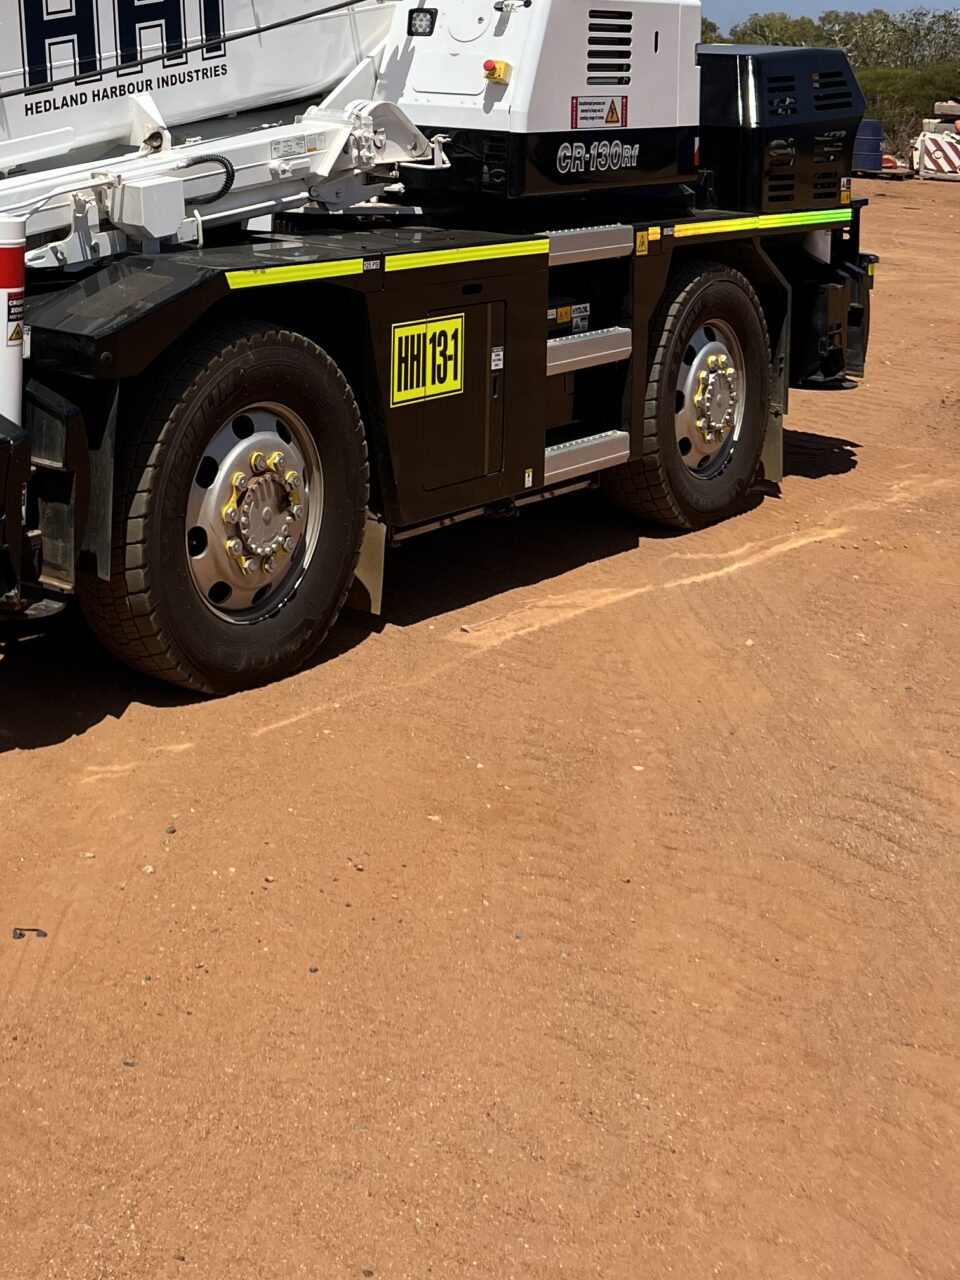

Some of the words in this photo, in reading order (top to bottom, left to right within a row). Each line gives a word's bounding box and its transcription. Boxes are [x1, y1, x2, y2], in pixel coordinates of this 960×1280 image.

[24, 92, 88, 117] HEDLAND
[92, 79, 154, 102] HARBOUR
[157, 64, 228, 89] INDUSTRIES
